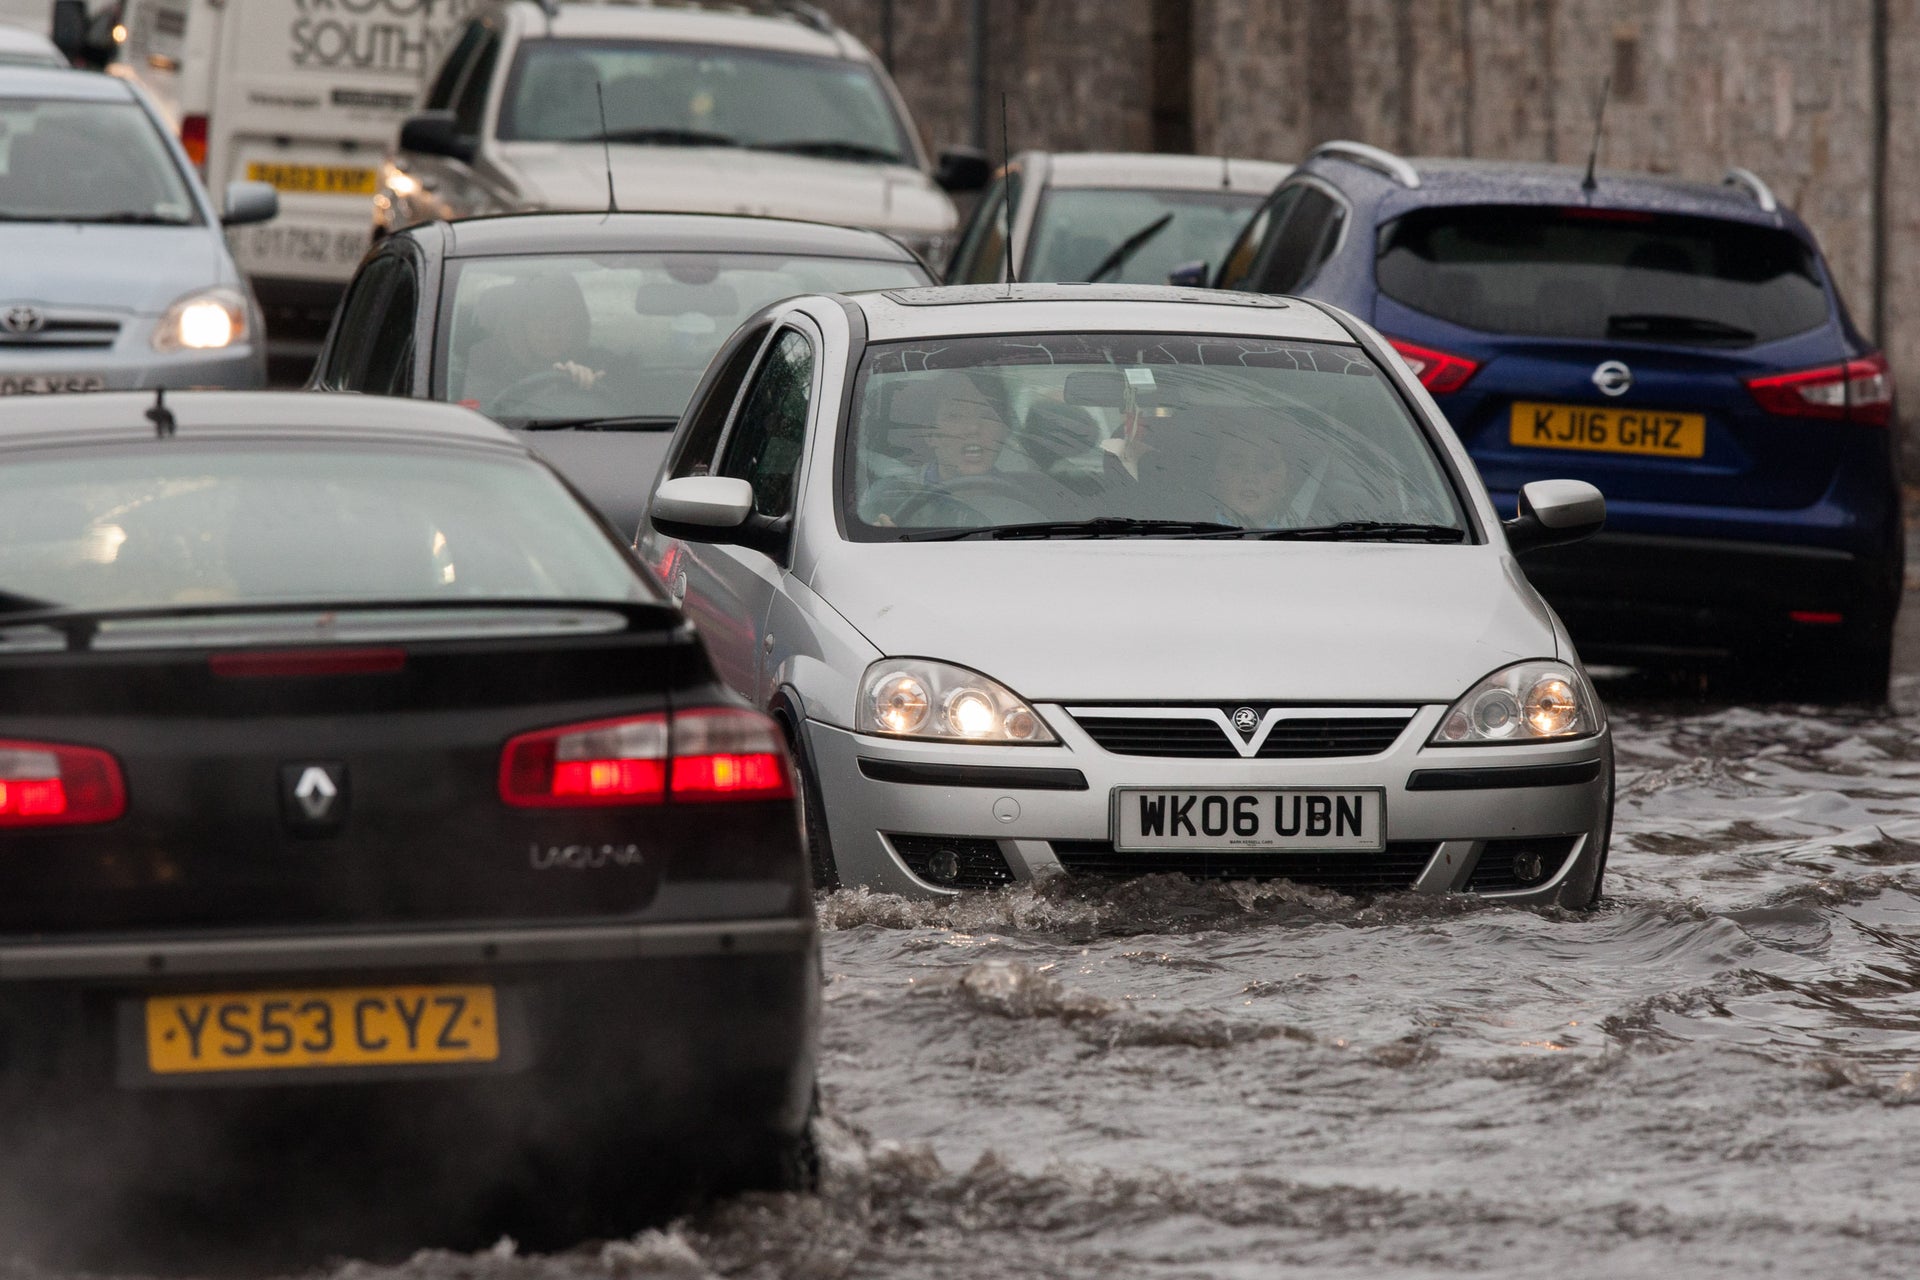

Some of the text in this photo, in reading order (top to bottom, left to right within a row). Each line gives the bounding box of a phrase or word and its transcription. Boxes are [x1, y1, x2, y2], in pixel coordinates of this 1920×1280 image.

[1533, 409, 1683, 449] KJ16 GHZ
[1139, 795, 1363, 837] WK06 UBN
[529, 842, 644, 870] LAGUNA
[176, 995, 470, 1060] YS53 CYZ
